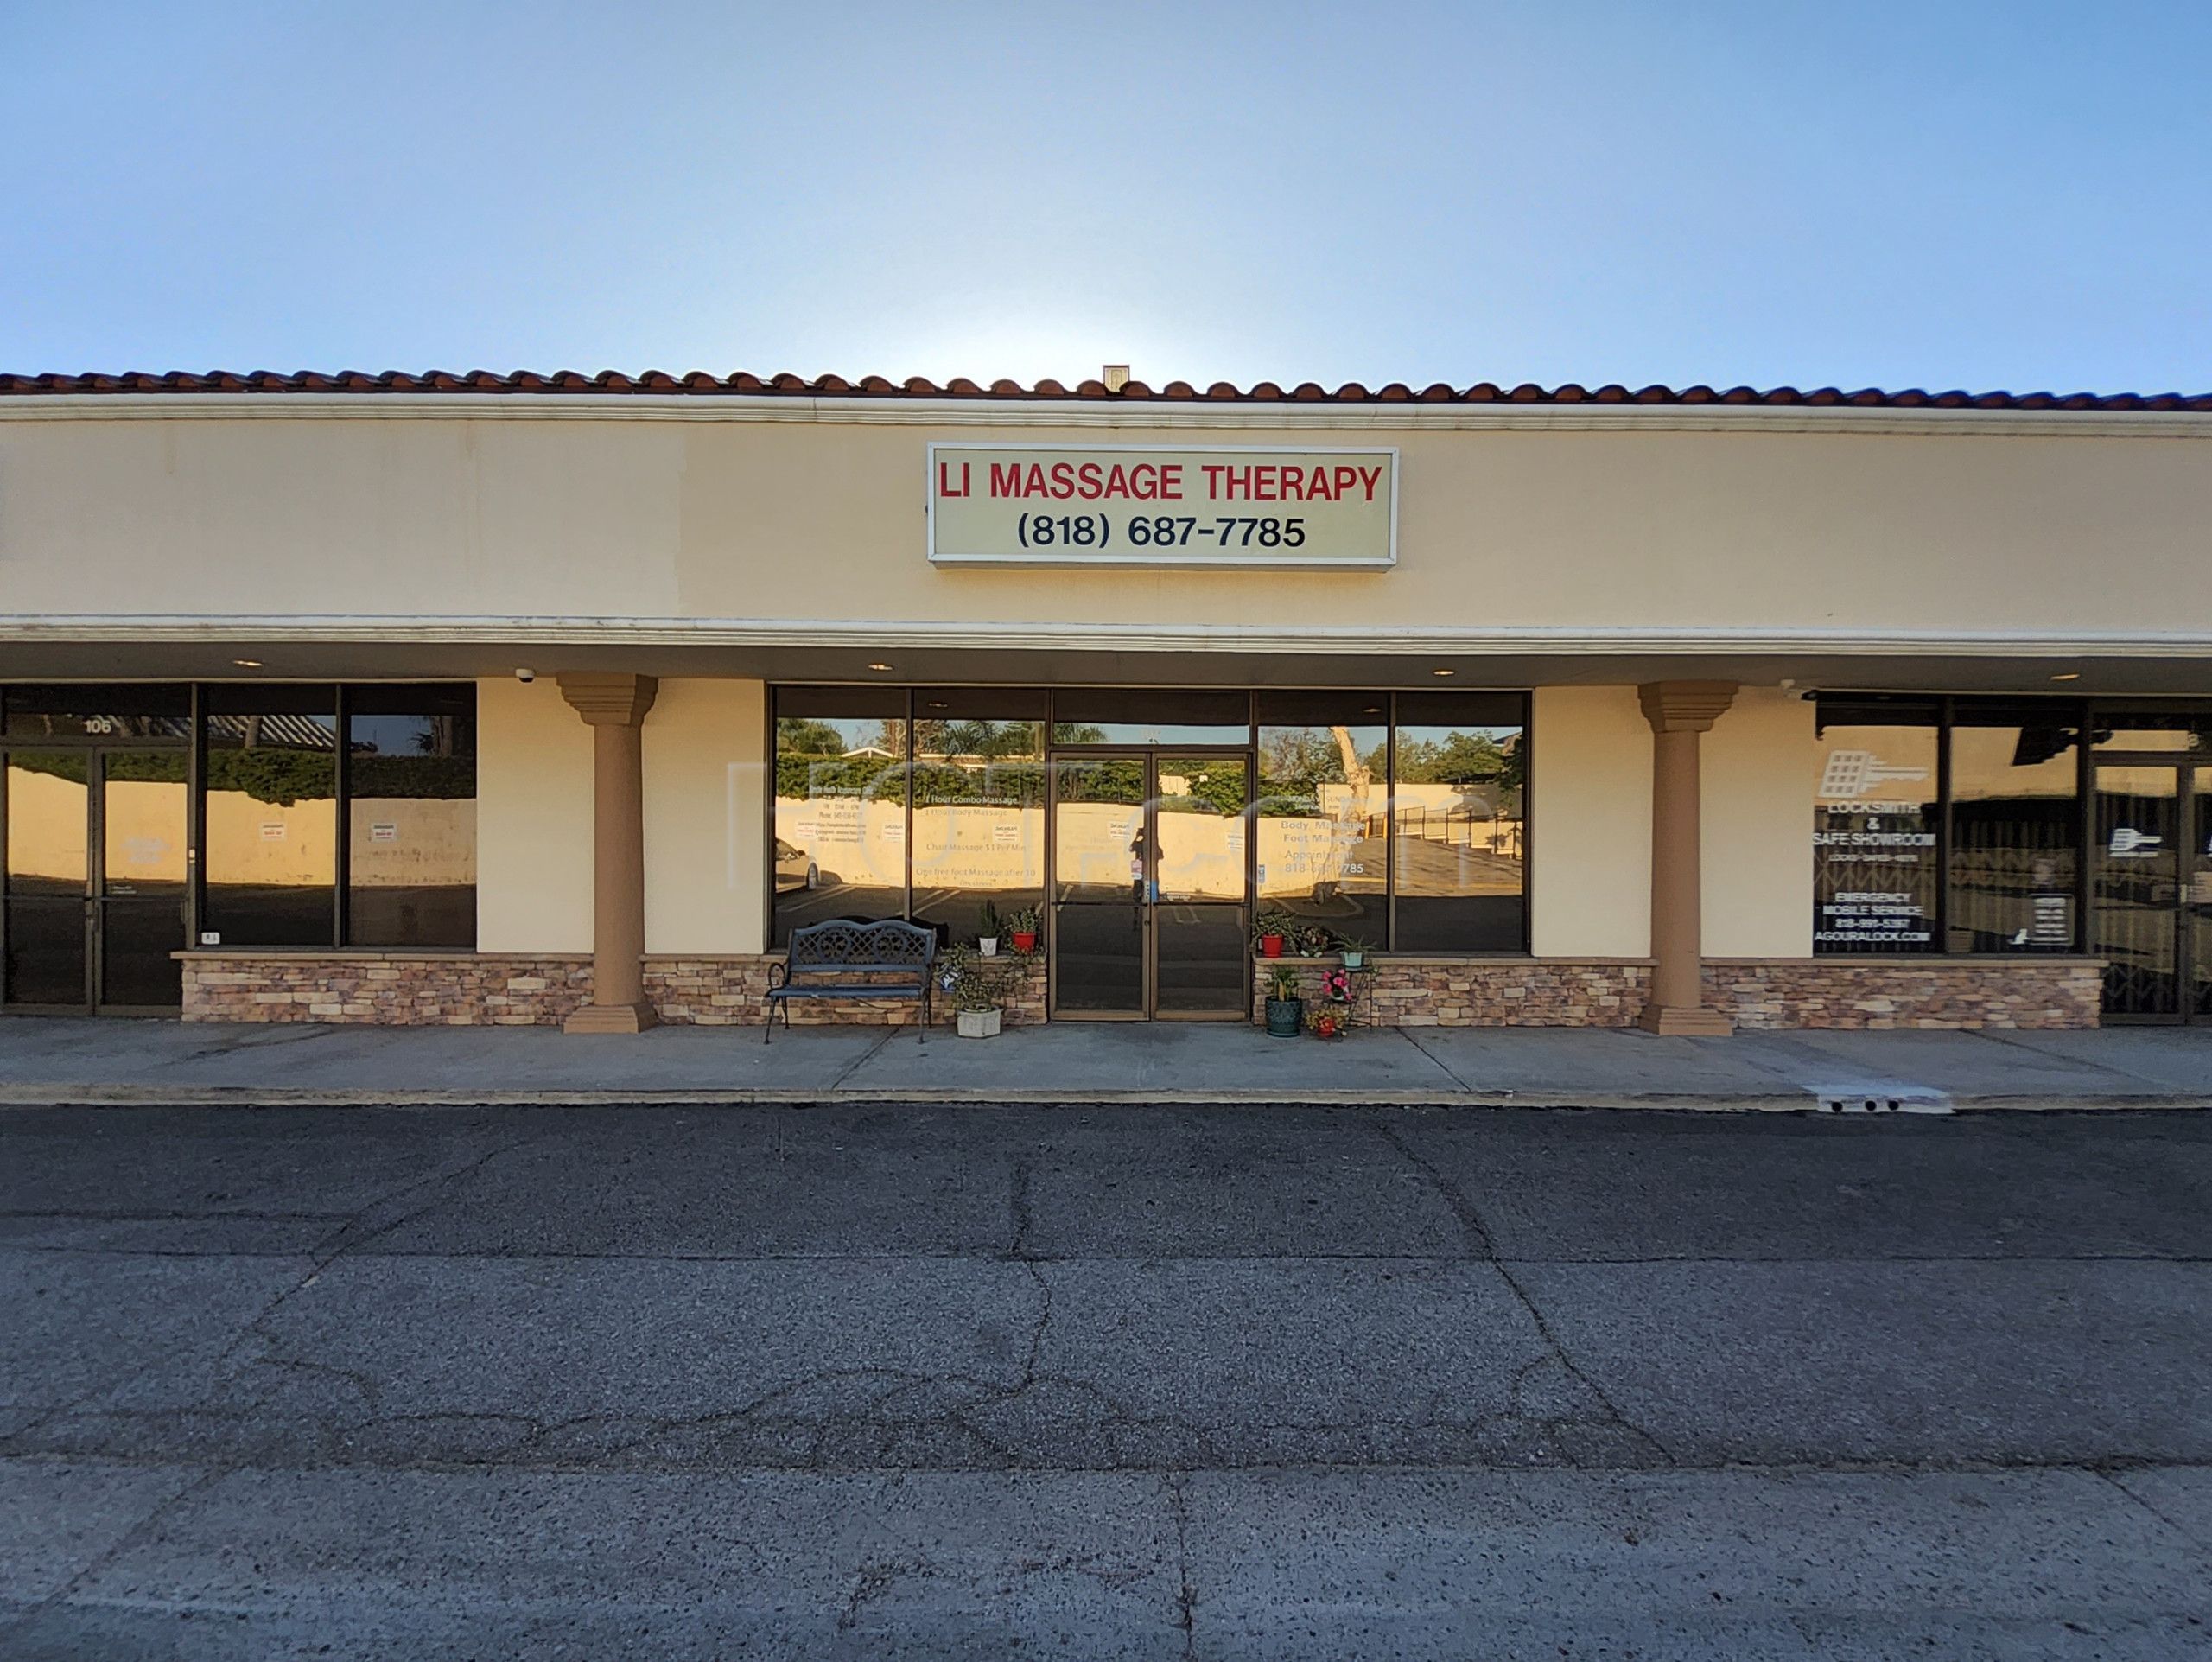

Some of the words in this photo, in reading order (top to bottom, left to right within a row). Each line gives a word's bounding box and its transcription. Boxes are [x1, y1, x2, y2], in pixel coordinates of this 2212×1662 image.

[939, 462, 970, 498] LI
[990, 462, 1184, 500] MASSAGE
[1201, 465, 1383, 501] THERAPY
[1018, 512, 1109, 549] (818)
[1128, 516, 1306, 548] 687-7785
[84, 720, 111, 734] 106
[952, 795, 982, 804] Combo
[982, 796, 1018, 805] Massage
[973, 809, 1007, 818] Massage
[1281, 820, 1309, 830] Body
[1866, 817, 1881, 830] &
[1284, 834, 1309, 843] Foot
[1812, 832, 1850, 845] SAFE
[1850, 833, 1936, 846] SHOWROOM
[950, 844, 983, 853] Massage
[969, 869, 1004, 878] Massage
